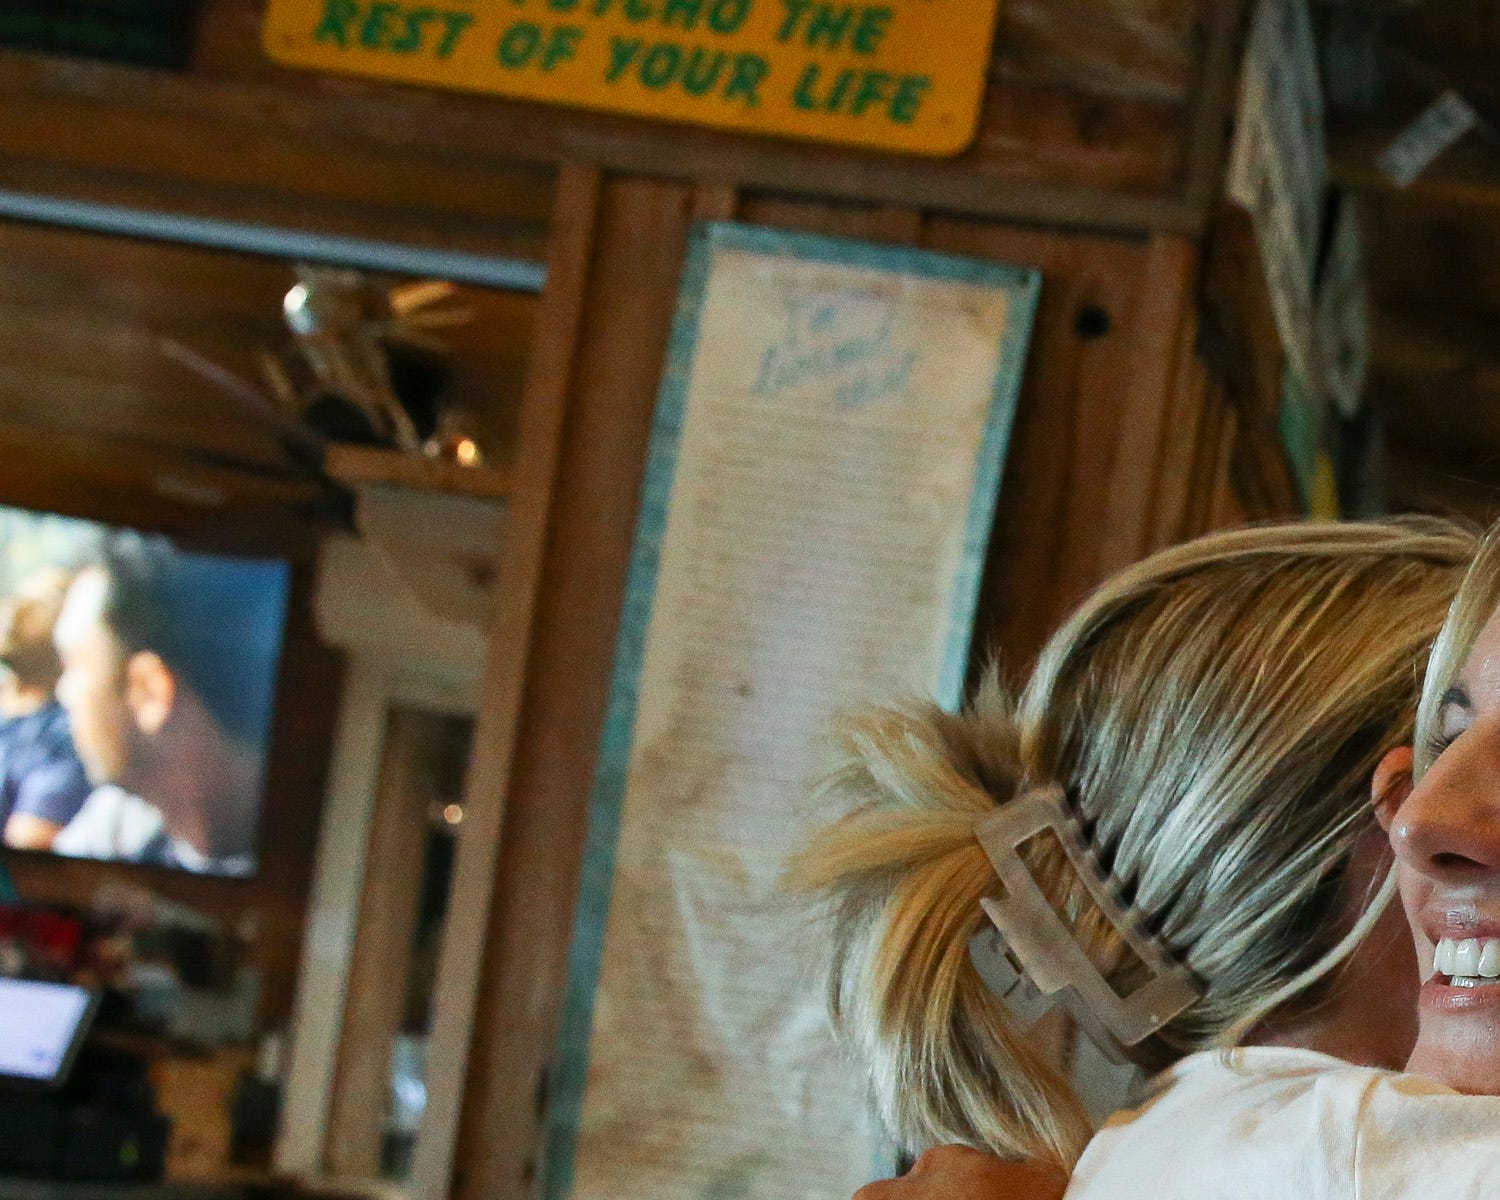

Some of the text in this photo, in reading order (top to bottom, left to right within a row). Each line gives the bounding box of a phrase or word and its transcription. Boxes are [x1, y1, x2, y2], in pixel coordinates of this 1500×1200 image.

[313, 0, 932, 124] REST OF YOUR LIFE
[507, 0, 893, 53] CHO THE
